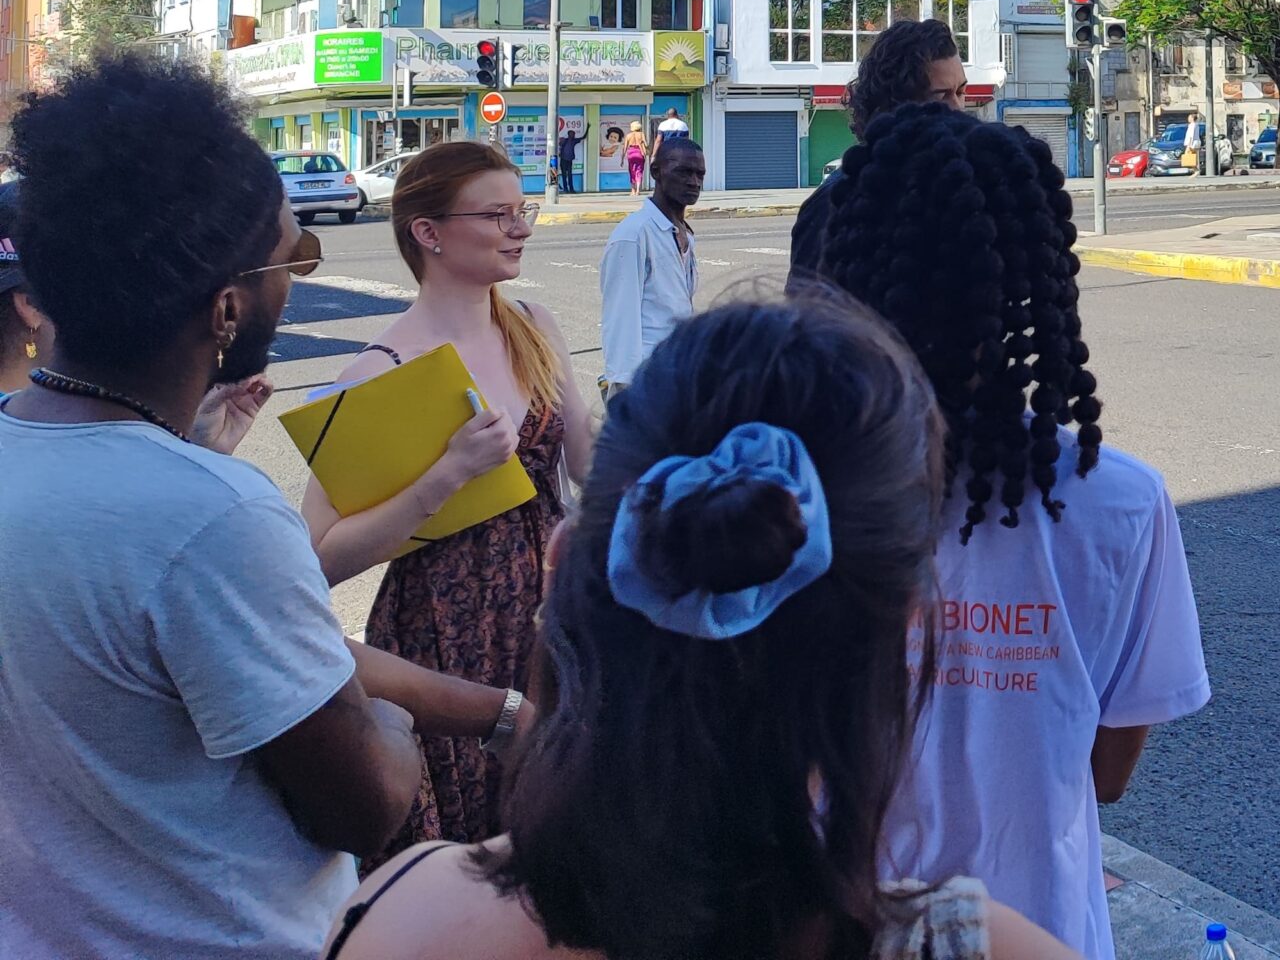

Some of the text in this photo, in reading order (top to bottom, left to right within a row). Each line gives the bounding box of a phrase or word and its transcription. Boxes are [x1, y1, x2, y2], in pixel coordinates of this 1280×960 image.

[557, 40, 643, 61] CYPRIA
[911, 600, 1057, 635] BIONET
[959, 641, 983, 657] NEW
[986, 645, 1060, 661] CARIBBEAN
